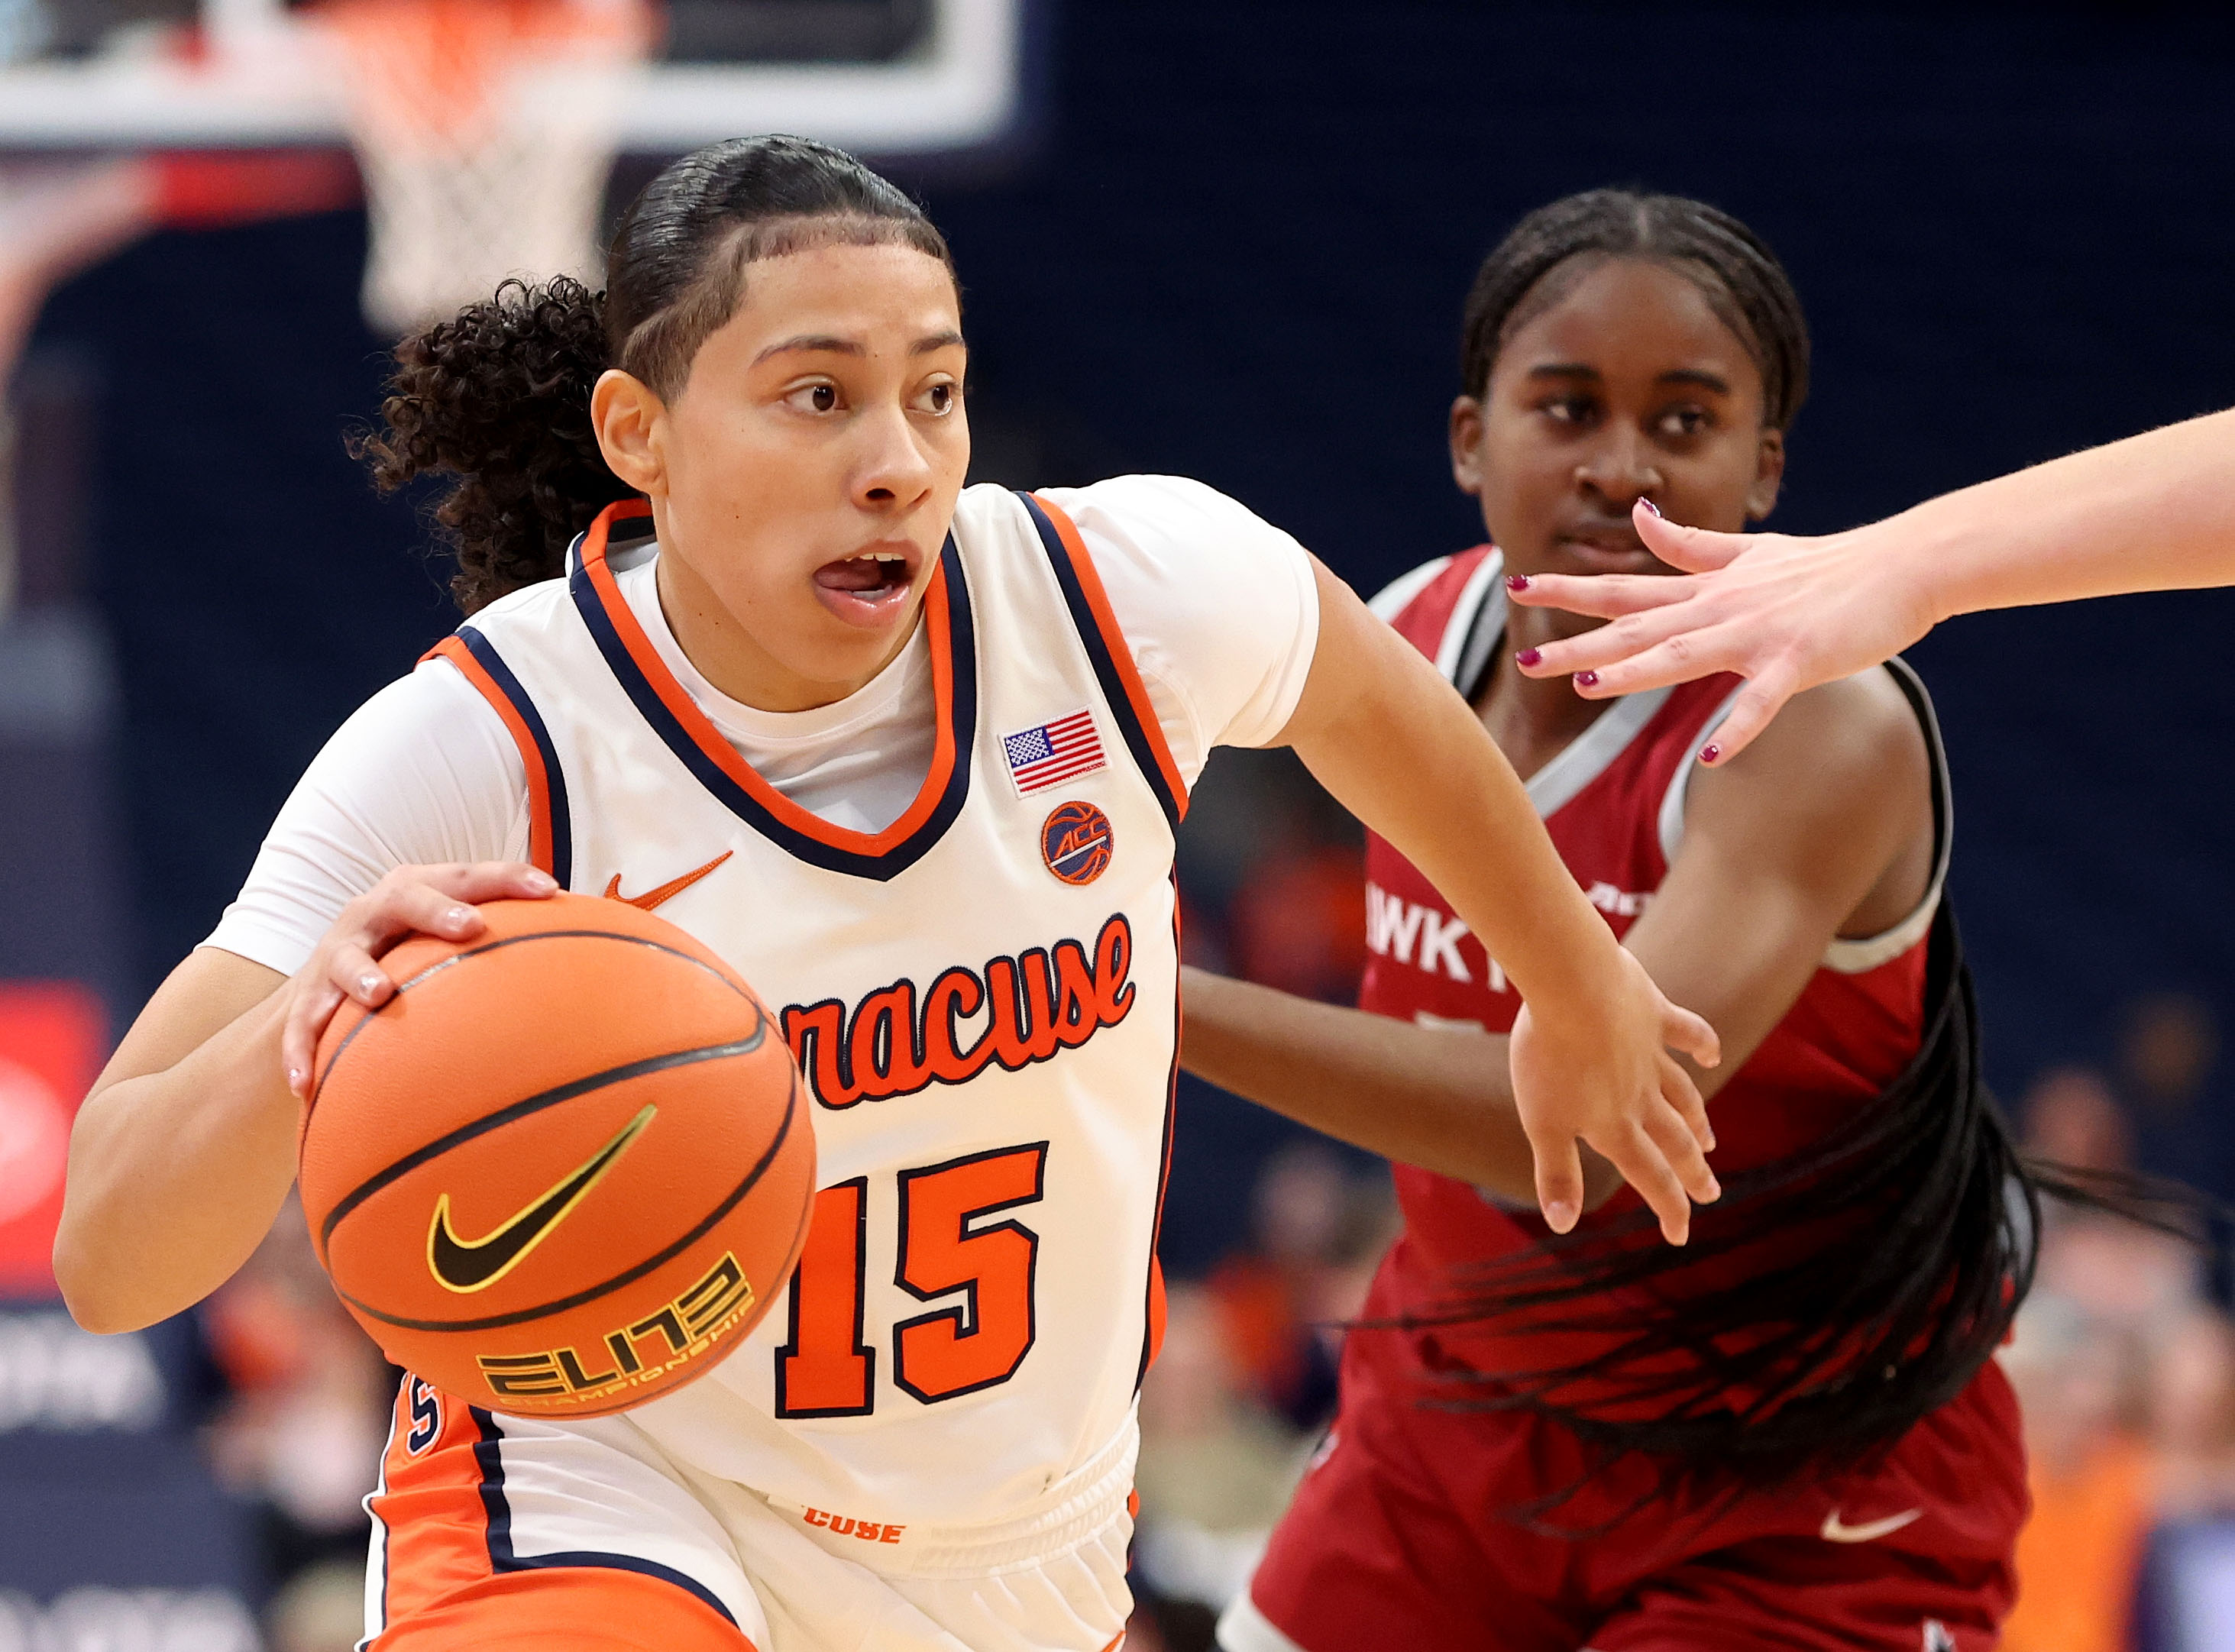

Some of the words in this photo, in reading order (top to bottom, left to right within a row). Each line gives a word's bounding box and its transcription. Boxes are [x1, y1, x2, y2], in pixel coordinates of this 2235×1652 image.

[1053, 815, 1108, 859] ACC
[1366, 881, 1473, 984] WK
[779, 913, 1137, 1110] racuse
[475, 1250, 752, 1397] ELITE
[775, 1140, 1050, 1420] 15
[803, 1507, 907, 1544] CUSE
